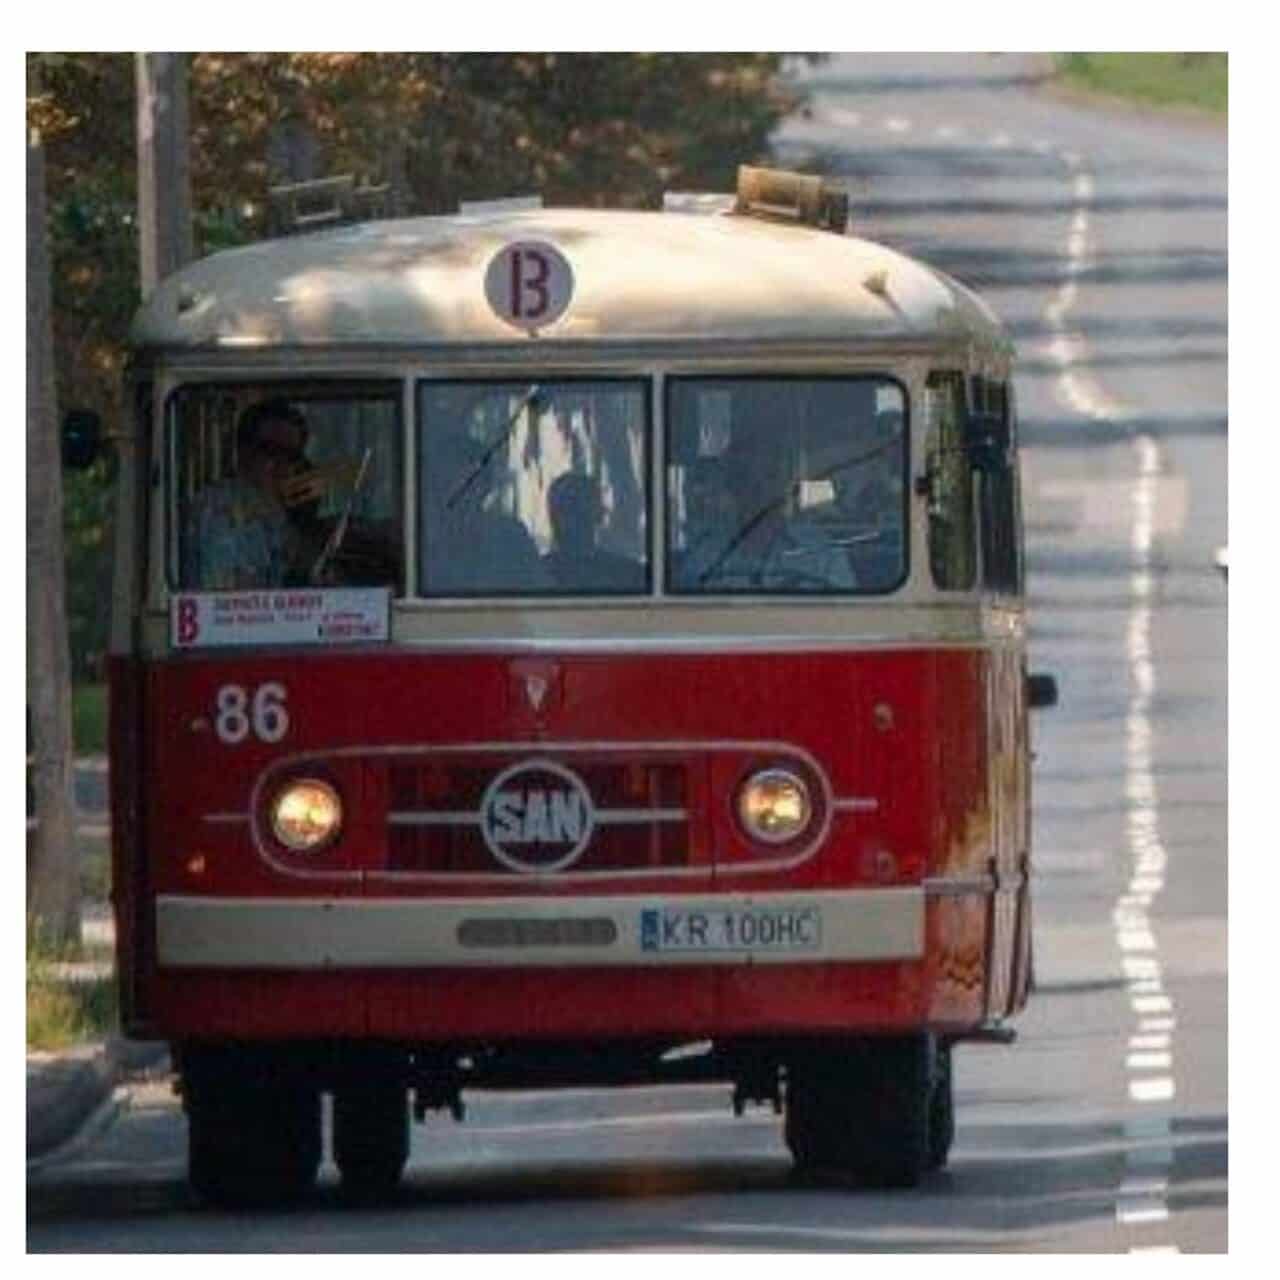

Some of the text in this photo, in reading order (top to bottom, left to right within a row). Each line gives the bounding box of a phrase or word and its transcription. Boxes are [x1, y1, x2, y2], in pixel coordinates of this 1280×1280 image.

[511, 249, 550, 319] B
[216, 683, 289, 743] 86
[491, 790, 582, 842] SAN
[663, 913, 708, 945] KR
[723, 911, 811, 945] 100HC
